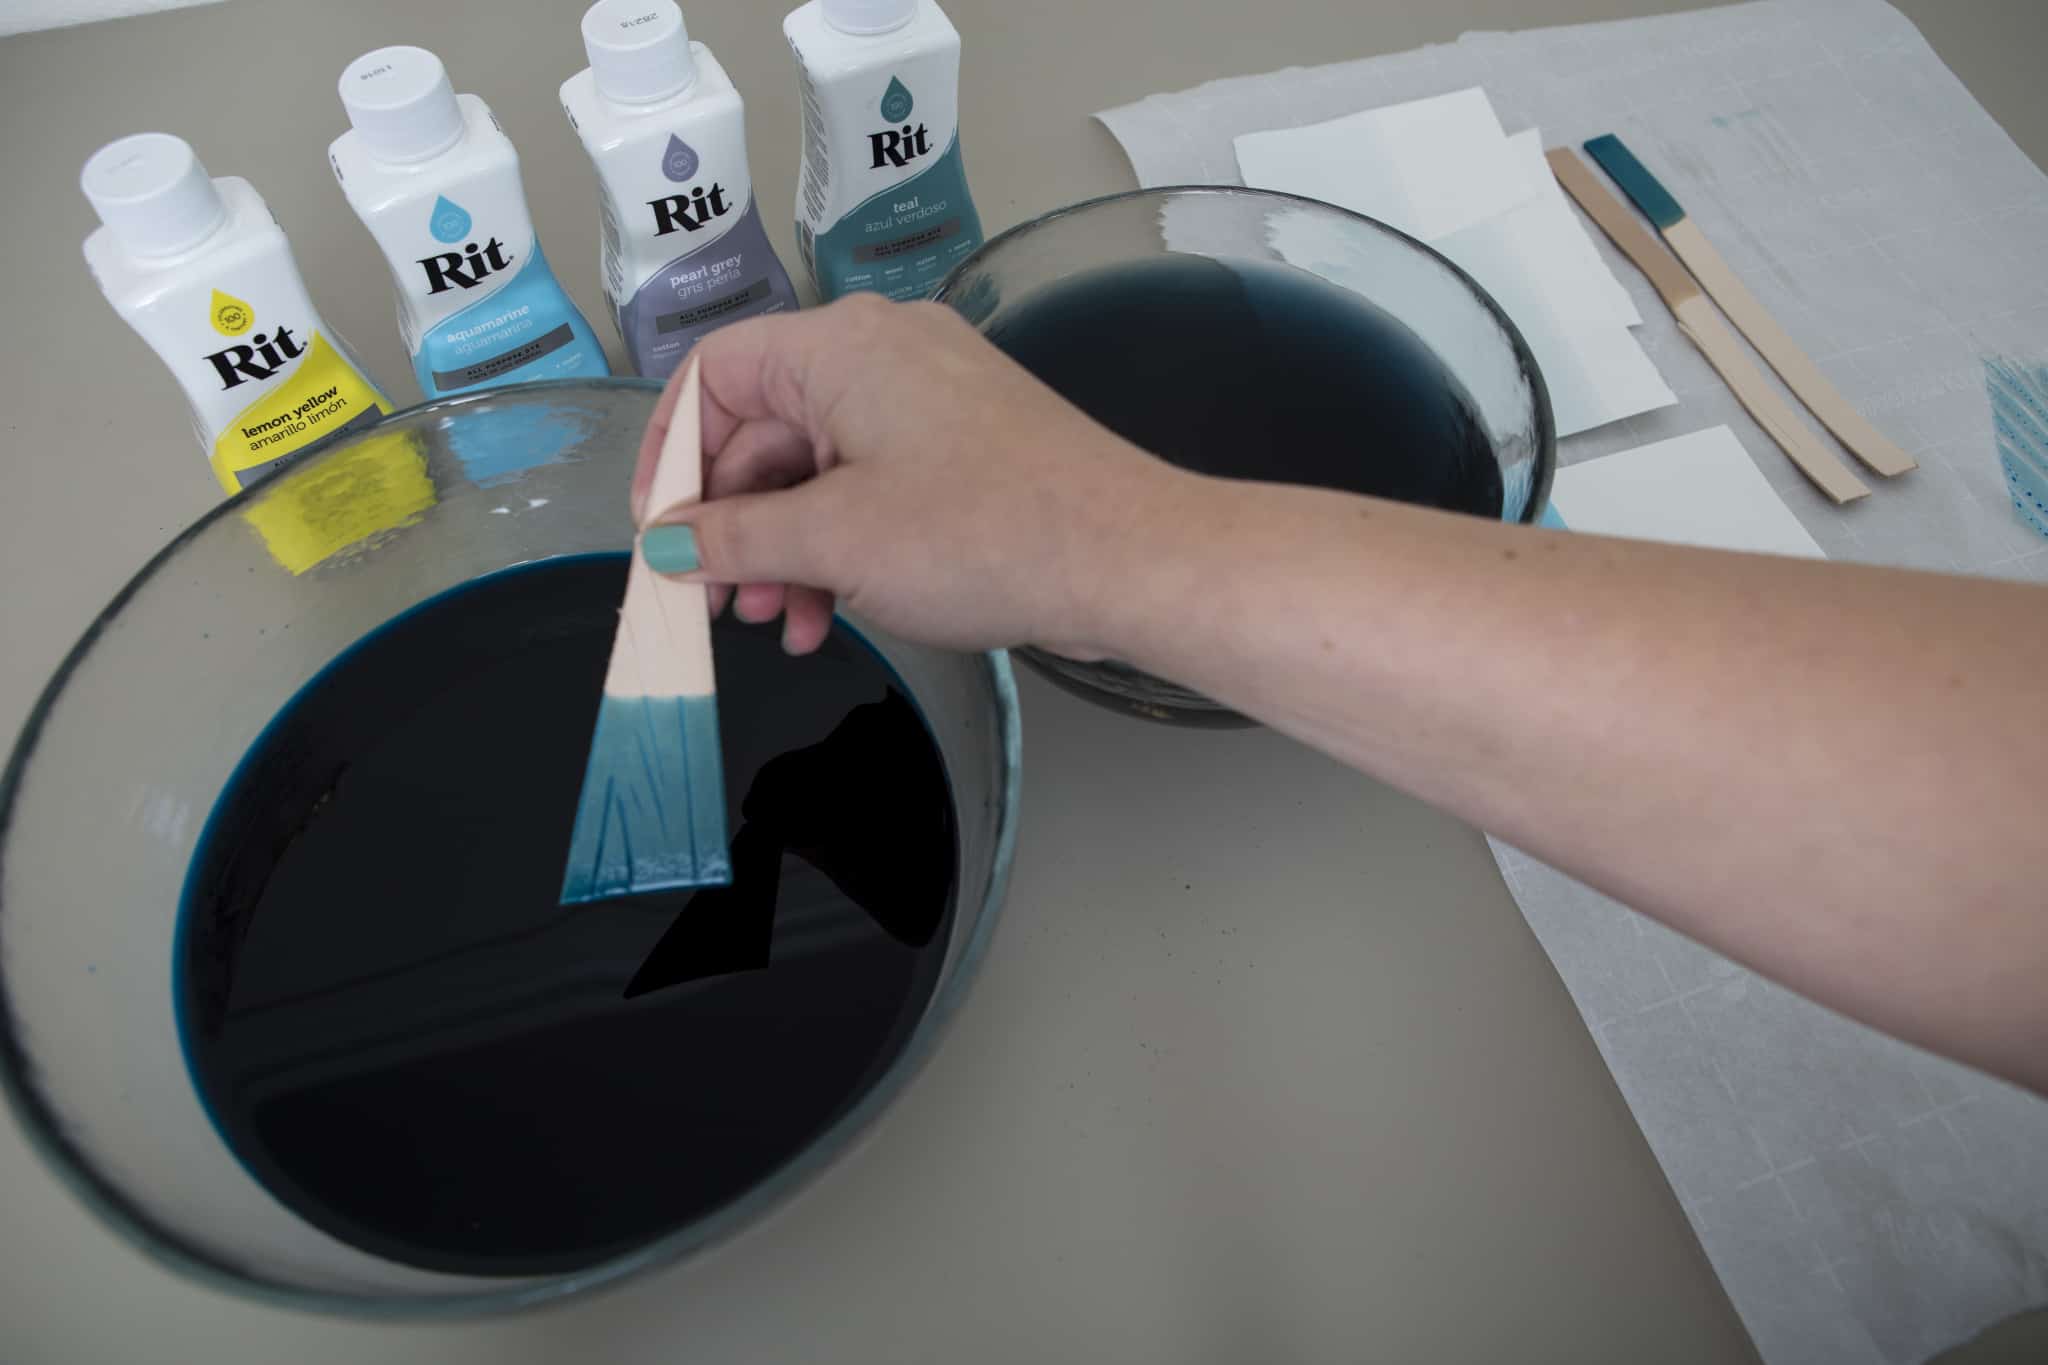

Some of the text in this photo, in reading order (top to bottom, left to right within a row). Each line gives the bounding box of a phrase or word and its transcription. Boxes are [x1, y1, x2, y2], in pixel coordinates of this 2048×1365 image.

[866, 122, 930, 170] Rit
[645, 182, 730, 237] Rit
[865, 200, 947, 232] azul verdoso
[893, 196, 919, 213] teal
[416, 236, 511, 295] Rit
[670, 254, 742, 288] pearl grey
[678, 282, 703, 300] gris
[447, 305, 529, 343] aquamarine
[202, 325, 304, 391] Rit
[241, 386, 338, 439] lemon yellow
[249, 420, 307, 451] amarillo
[307, 397, 347, 425] limón
